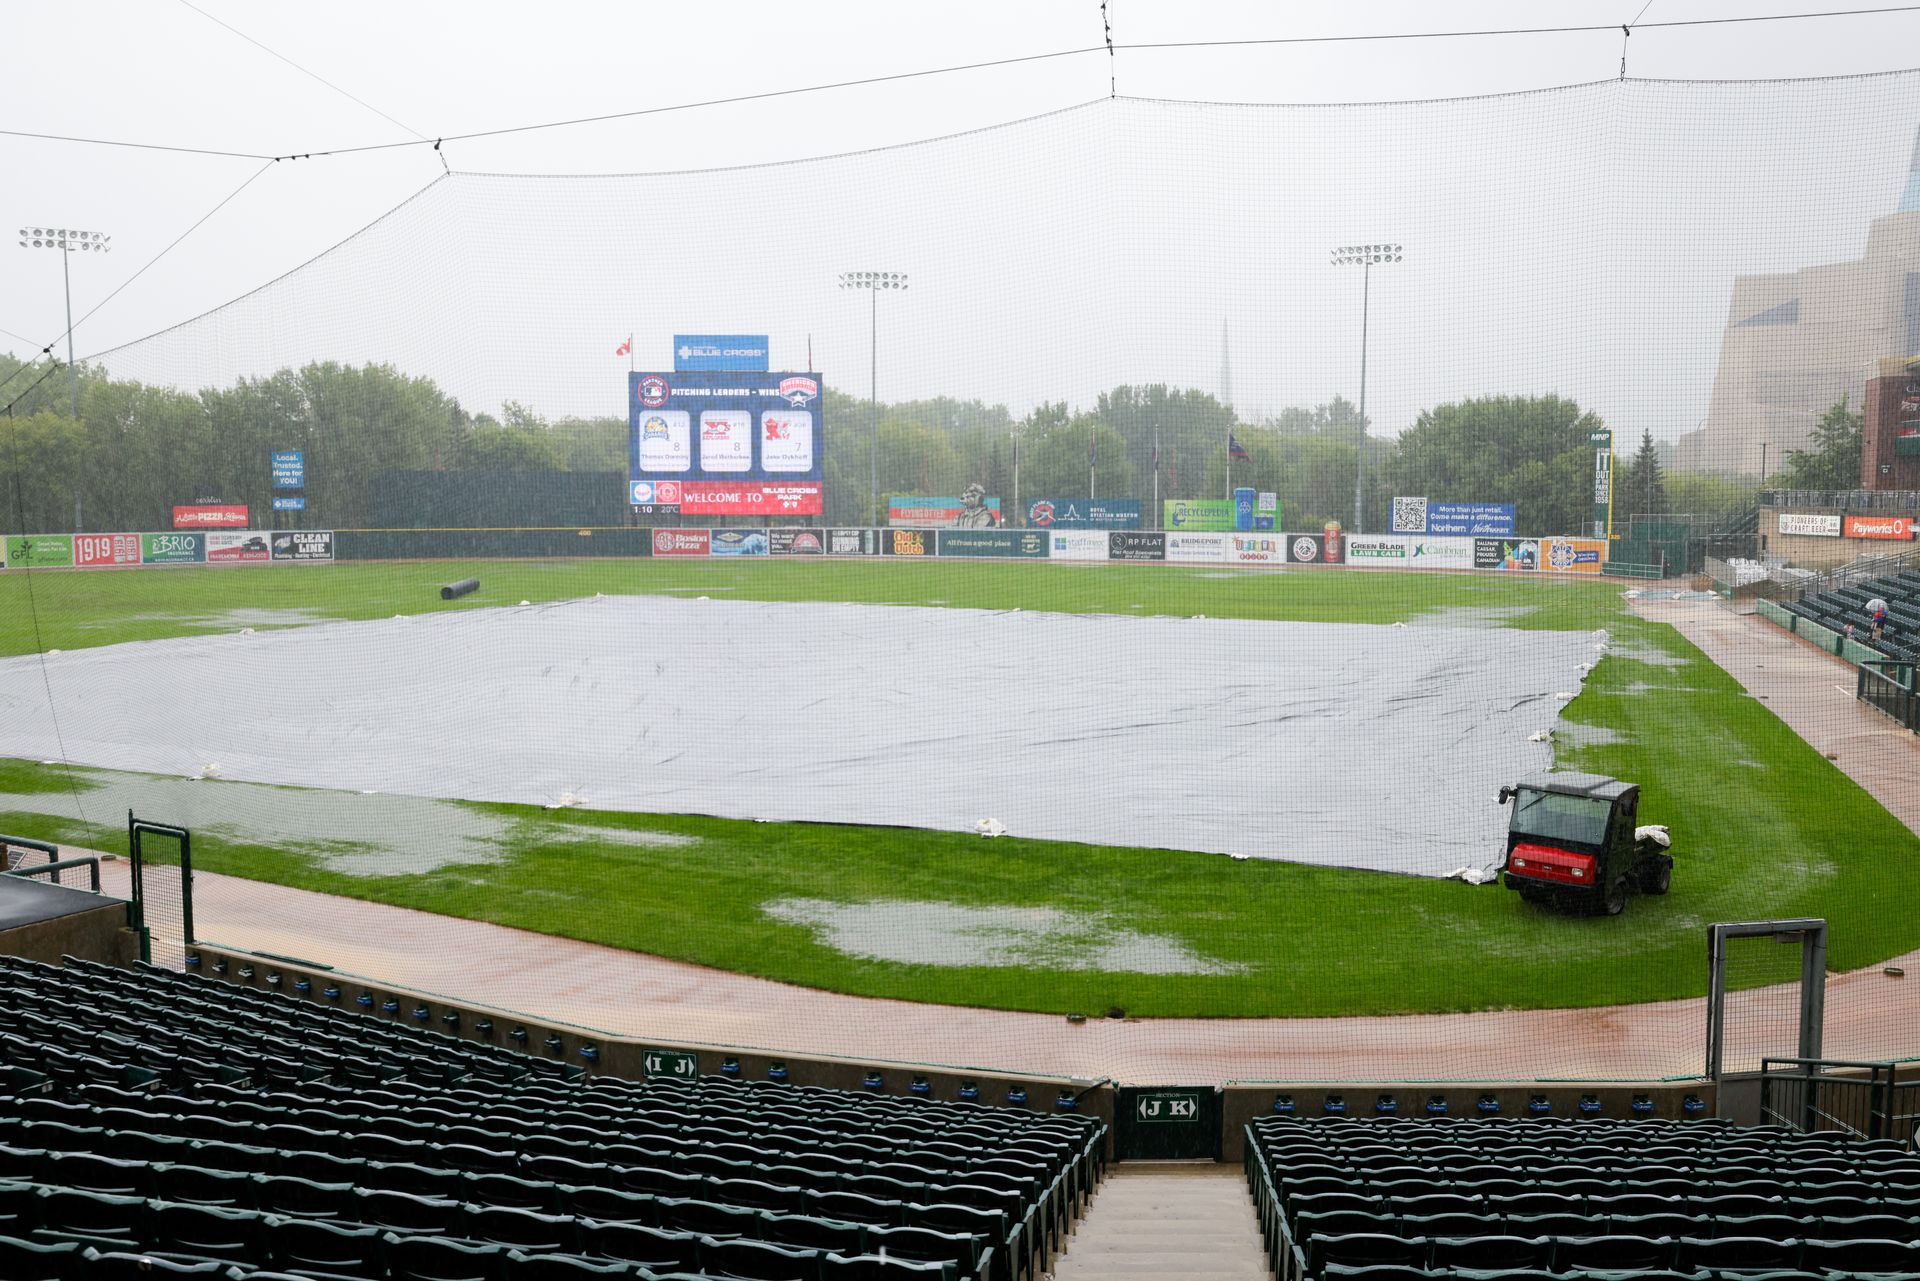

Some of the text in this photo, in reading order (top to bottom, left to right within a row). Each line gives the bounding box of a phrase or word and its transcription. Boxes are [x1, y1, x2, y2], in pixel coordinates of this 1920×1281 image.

[671, 388, 780, 396] PITCHING LEADERS WINS
[674, 442, 680, 452] 8
[734, 442, 741, 452] 8
[795, 442, 802, 451] 7
[1596, 453, 1610, 471] IT
[1595, 471, 1609, 479] OUT
[684, 493, 762, 503] WELCOME TO
[1471, 506, 1484, 514] just
[198, 512, 223, 521] PIZZA
[1791, 517, 1827, 525] PIONEERS OF
[1431, 524, 1466, 533] Northern
[1810, 525, 1827, 533] BEER
[1853, 522, 1893, 535] Payworks
[293, 533, 330, 543] CLEAN
[676, 534, 707, 542] Boston
[894, 530, 914, 543] Old
[157, 535, 195, 552] BRIO
[299, 544, 325, 553] LINE
[894, 542, 924, 555] Dutch
[1351, 542, 1405, 550] GREEN BLADE
[77, 538, 111, 563] 1919
[652, 1057, 687, 1073] I J
[1147, 1101, 1189, 1116] J K
